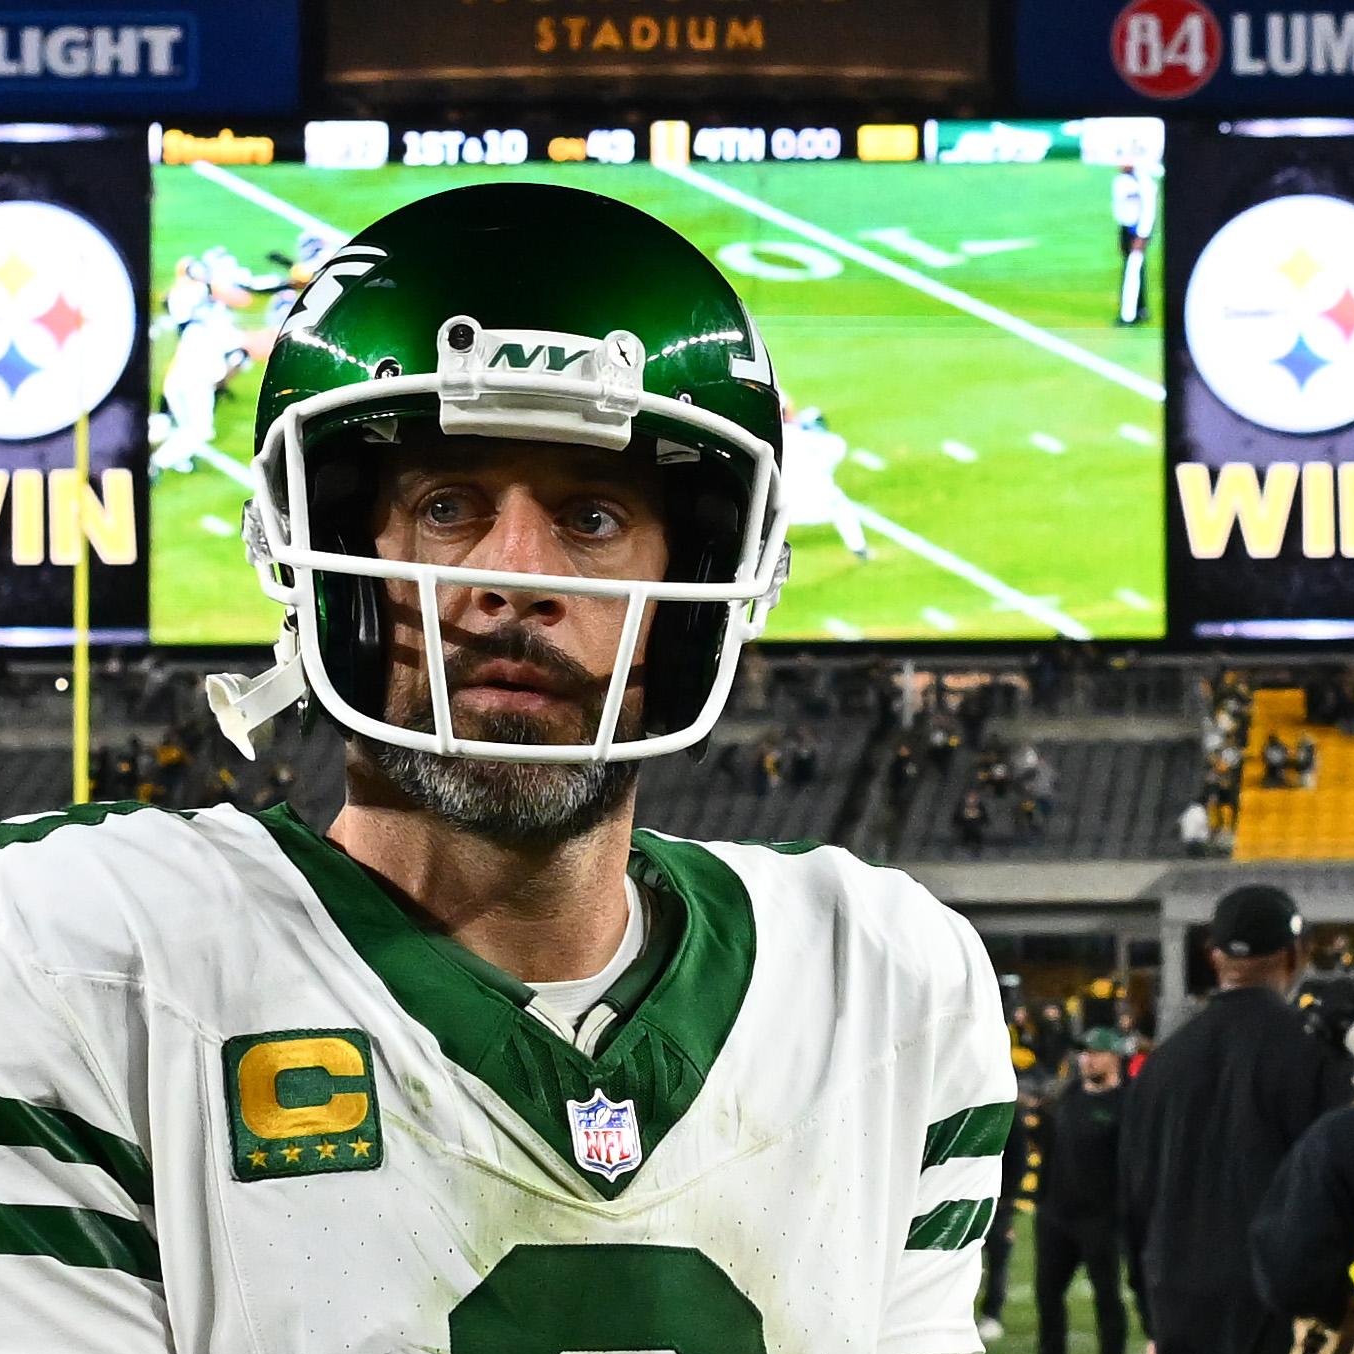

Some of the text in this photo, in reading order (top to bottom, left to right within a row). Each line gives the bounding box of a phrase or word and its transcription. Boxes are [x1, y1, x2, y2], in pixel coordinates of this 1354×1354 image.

[536, 16, 765, 52] STADIUM
[1125, 13, 1207, 76] 84
[487, 343, 591, 372] NY
[238, 1036, 369, 1140] C
[583, 1129, 632, 1165] NFL
